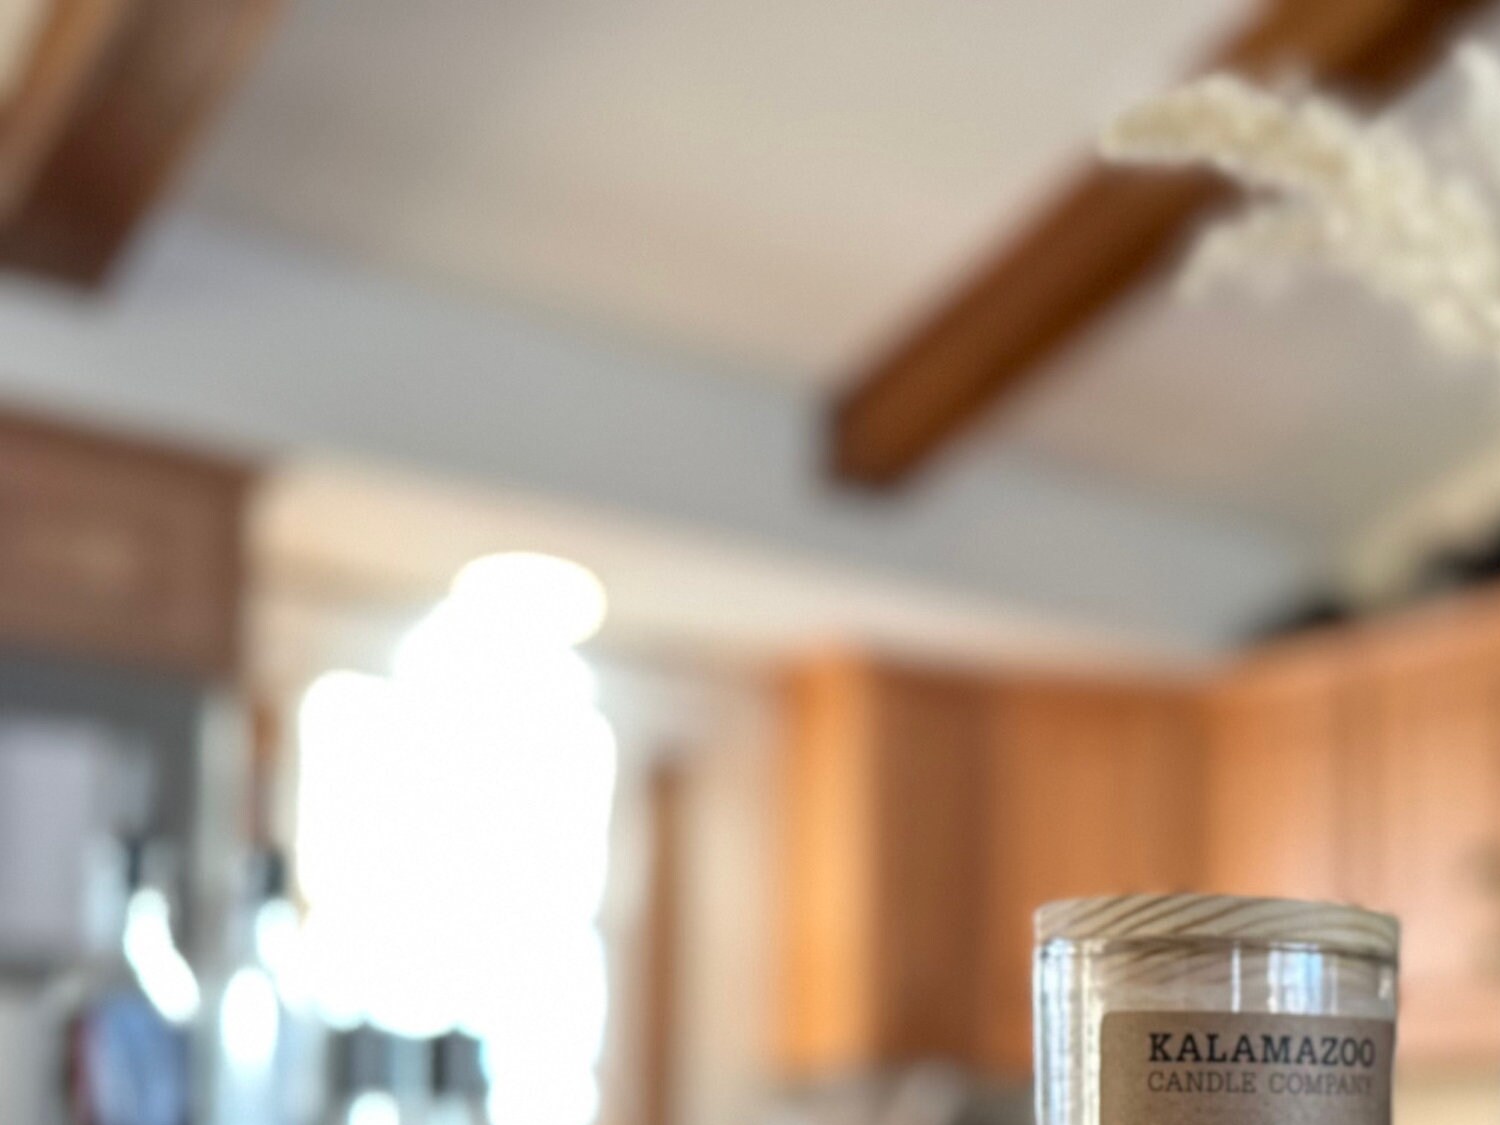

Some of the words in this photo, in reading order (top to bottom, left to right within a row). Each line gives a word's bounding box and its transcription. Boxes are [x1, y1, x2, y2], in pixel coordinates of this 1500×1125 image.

[1148, 1033, 1376, 1067] KALAMAZOO
[1147, 1070, 1257, 1094] CANDLE
[1268, 1072, 1373, 1096] COMPANY
